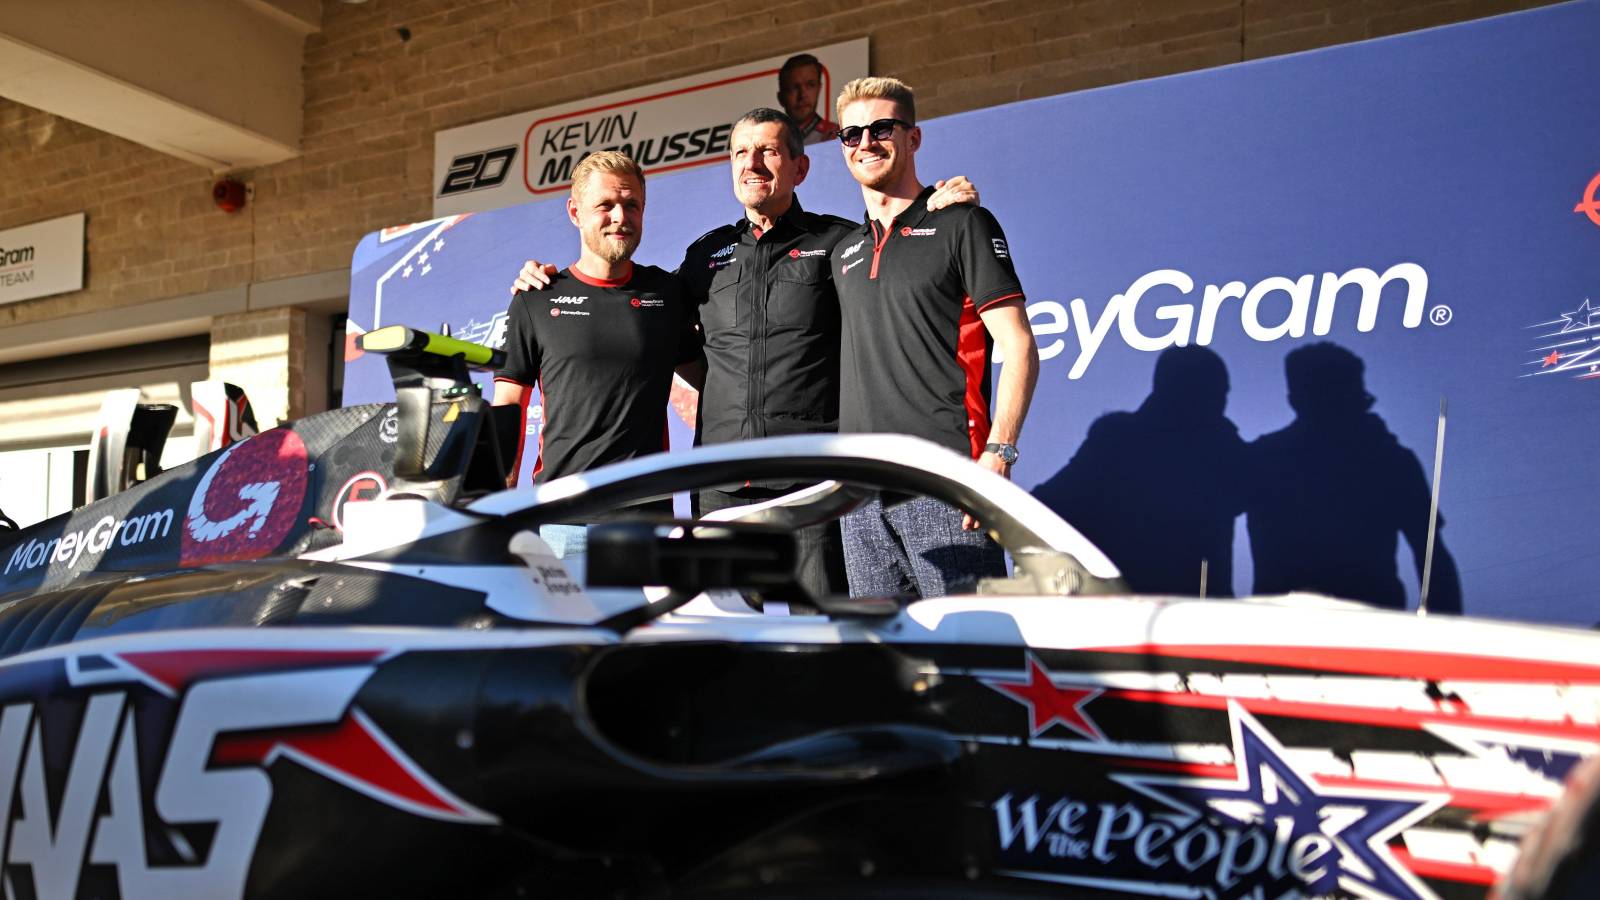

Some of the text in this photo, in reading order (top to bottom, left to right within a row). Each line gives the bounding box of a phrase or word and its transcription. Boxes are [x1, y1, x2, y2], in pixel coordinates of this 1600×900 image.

[540, 111, 637, 156] KEVIN
[437, 144, 519, 198] 20
[0, 269, 34, 287] TEAM
[549, 296, 589, 304] HAAS
[4, 508, 174, 575] MoneyGram
[992, 792, 1087, 853] We
[1092, 800, 1333, 891] People
